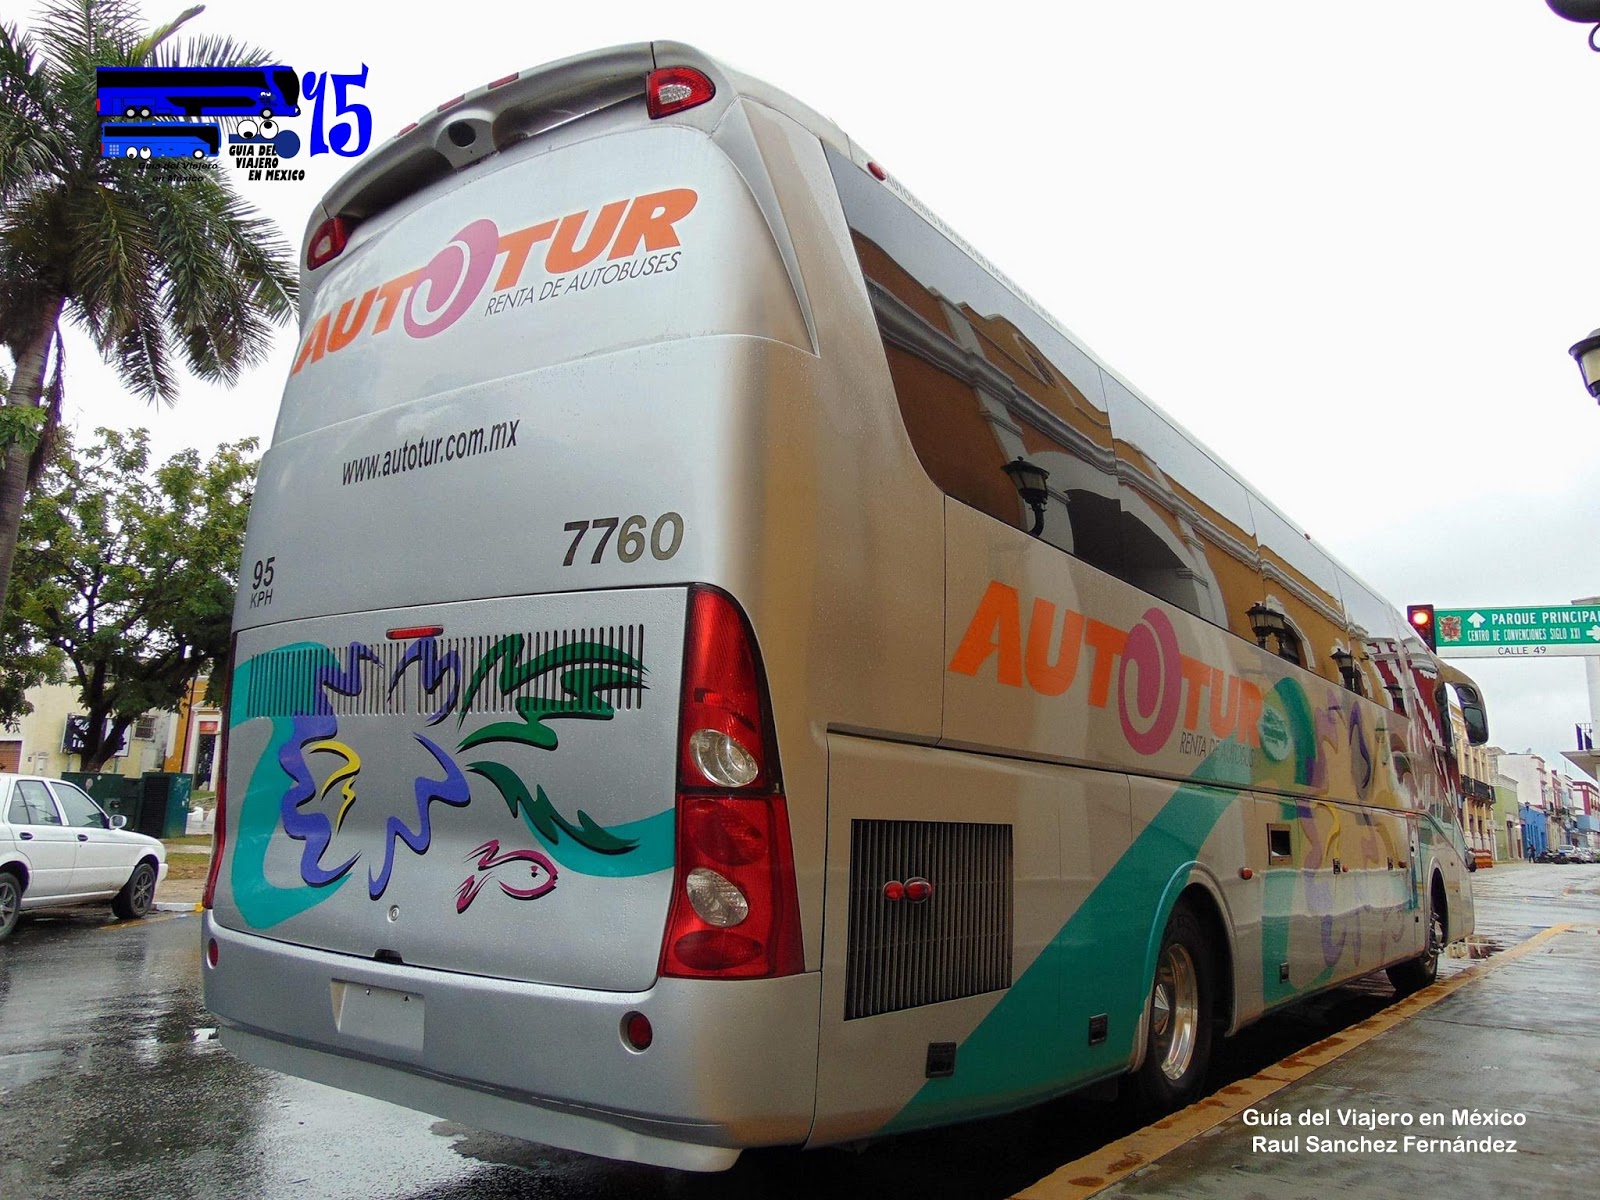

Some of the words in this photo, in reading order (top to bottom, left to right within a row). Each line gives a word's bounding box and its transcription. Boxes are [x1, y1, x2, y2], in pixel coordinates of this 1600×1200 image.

[291, 188, 698, 376] AUTOTUR
[485, 286, 534, 317] RENTA
[539, 277, 565, 301] DE
[564, 251, 681, 295] AUTOBUSES
[342, 419, 520, 485] www.autotur.com.mx
[562, 511, 685, 567] 7760
[252, 556, 276, 590] 95
[249, 589, 274, 609] KPH
[1467, 630, 1490, 641] CENTRO
[1493, 630, 1501, 641] DE
[1503, 628, 1547, 641] CONVENCIONES
[1550, 628, 1567, 640] SIGLO
[1570, 627, 1581, 640] XXI
[1491, 612, 1537, 625] PARQUE
[947, 579, 1264, 756] AUTOTUR
[1497, 646, 1529, 655] CALLE
[1533, 646, 1547, 655] 49
[1180, 731, 1207, 758] RENTA
